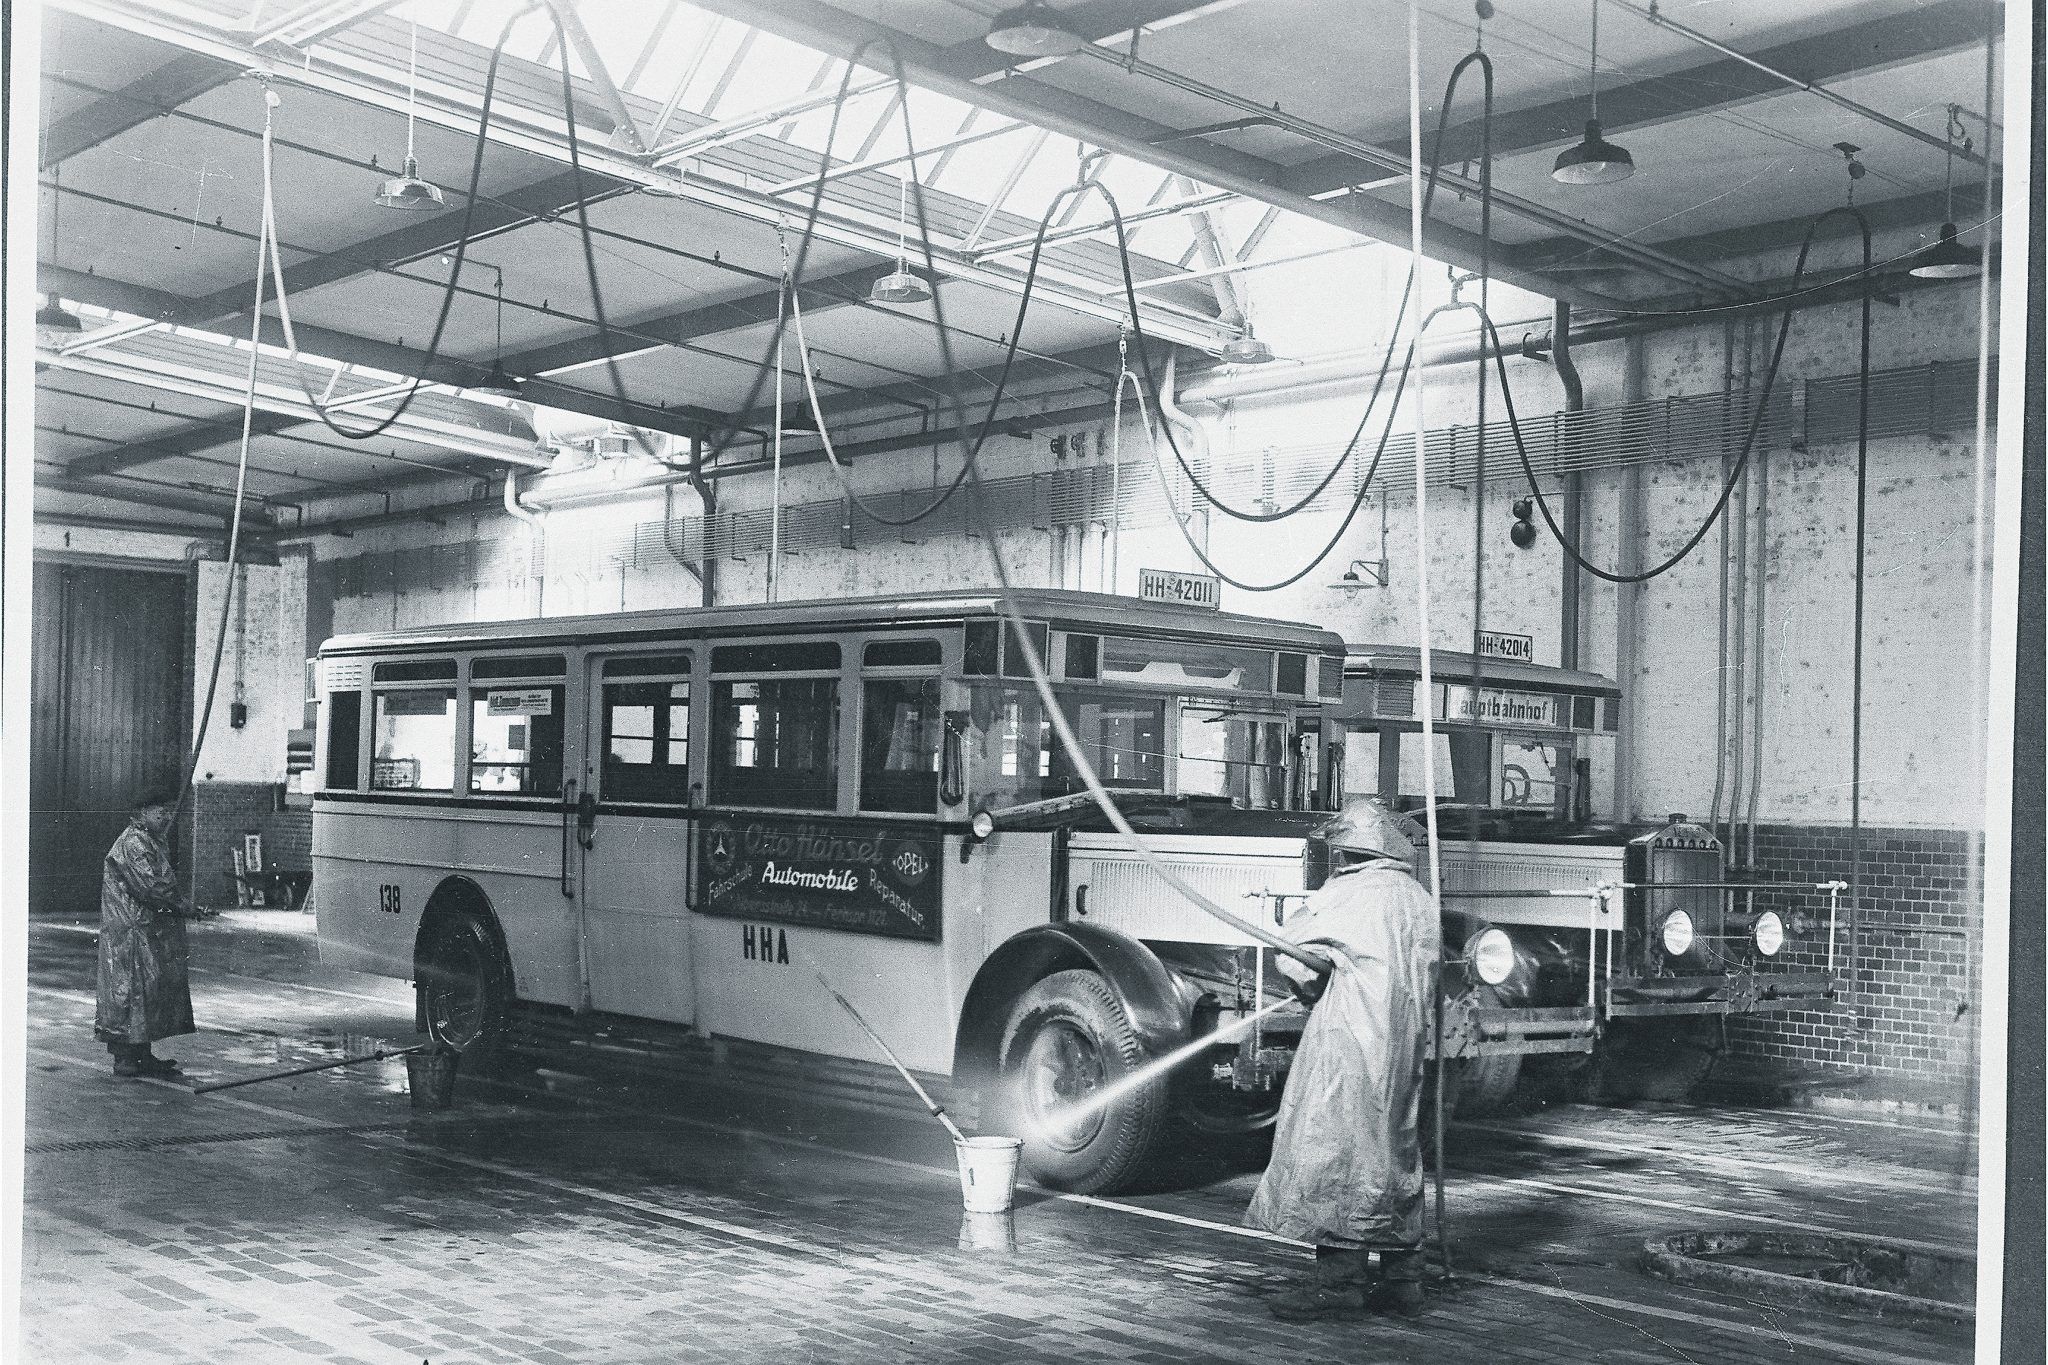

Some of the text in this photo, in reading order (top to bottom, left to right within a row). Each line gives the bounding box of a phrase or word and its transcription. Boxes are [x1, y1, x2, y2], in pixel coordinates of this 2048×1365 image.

[1144, 575, 1213, 603] HH-42011
[1479, 636, 1530, 657] HH-42014
[1460, 696, 1547, 720] auptbahnhof
[745, 823, 794, 856] Otto
[761, 861, 859, 892] Automobile
[896, 851, 924, 875] OPEL
[379, 883, 402, 914] 138
[743, 924, 790, 965] HHA
